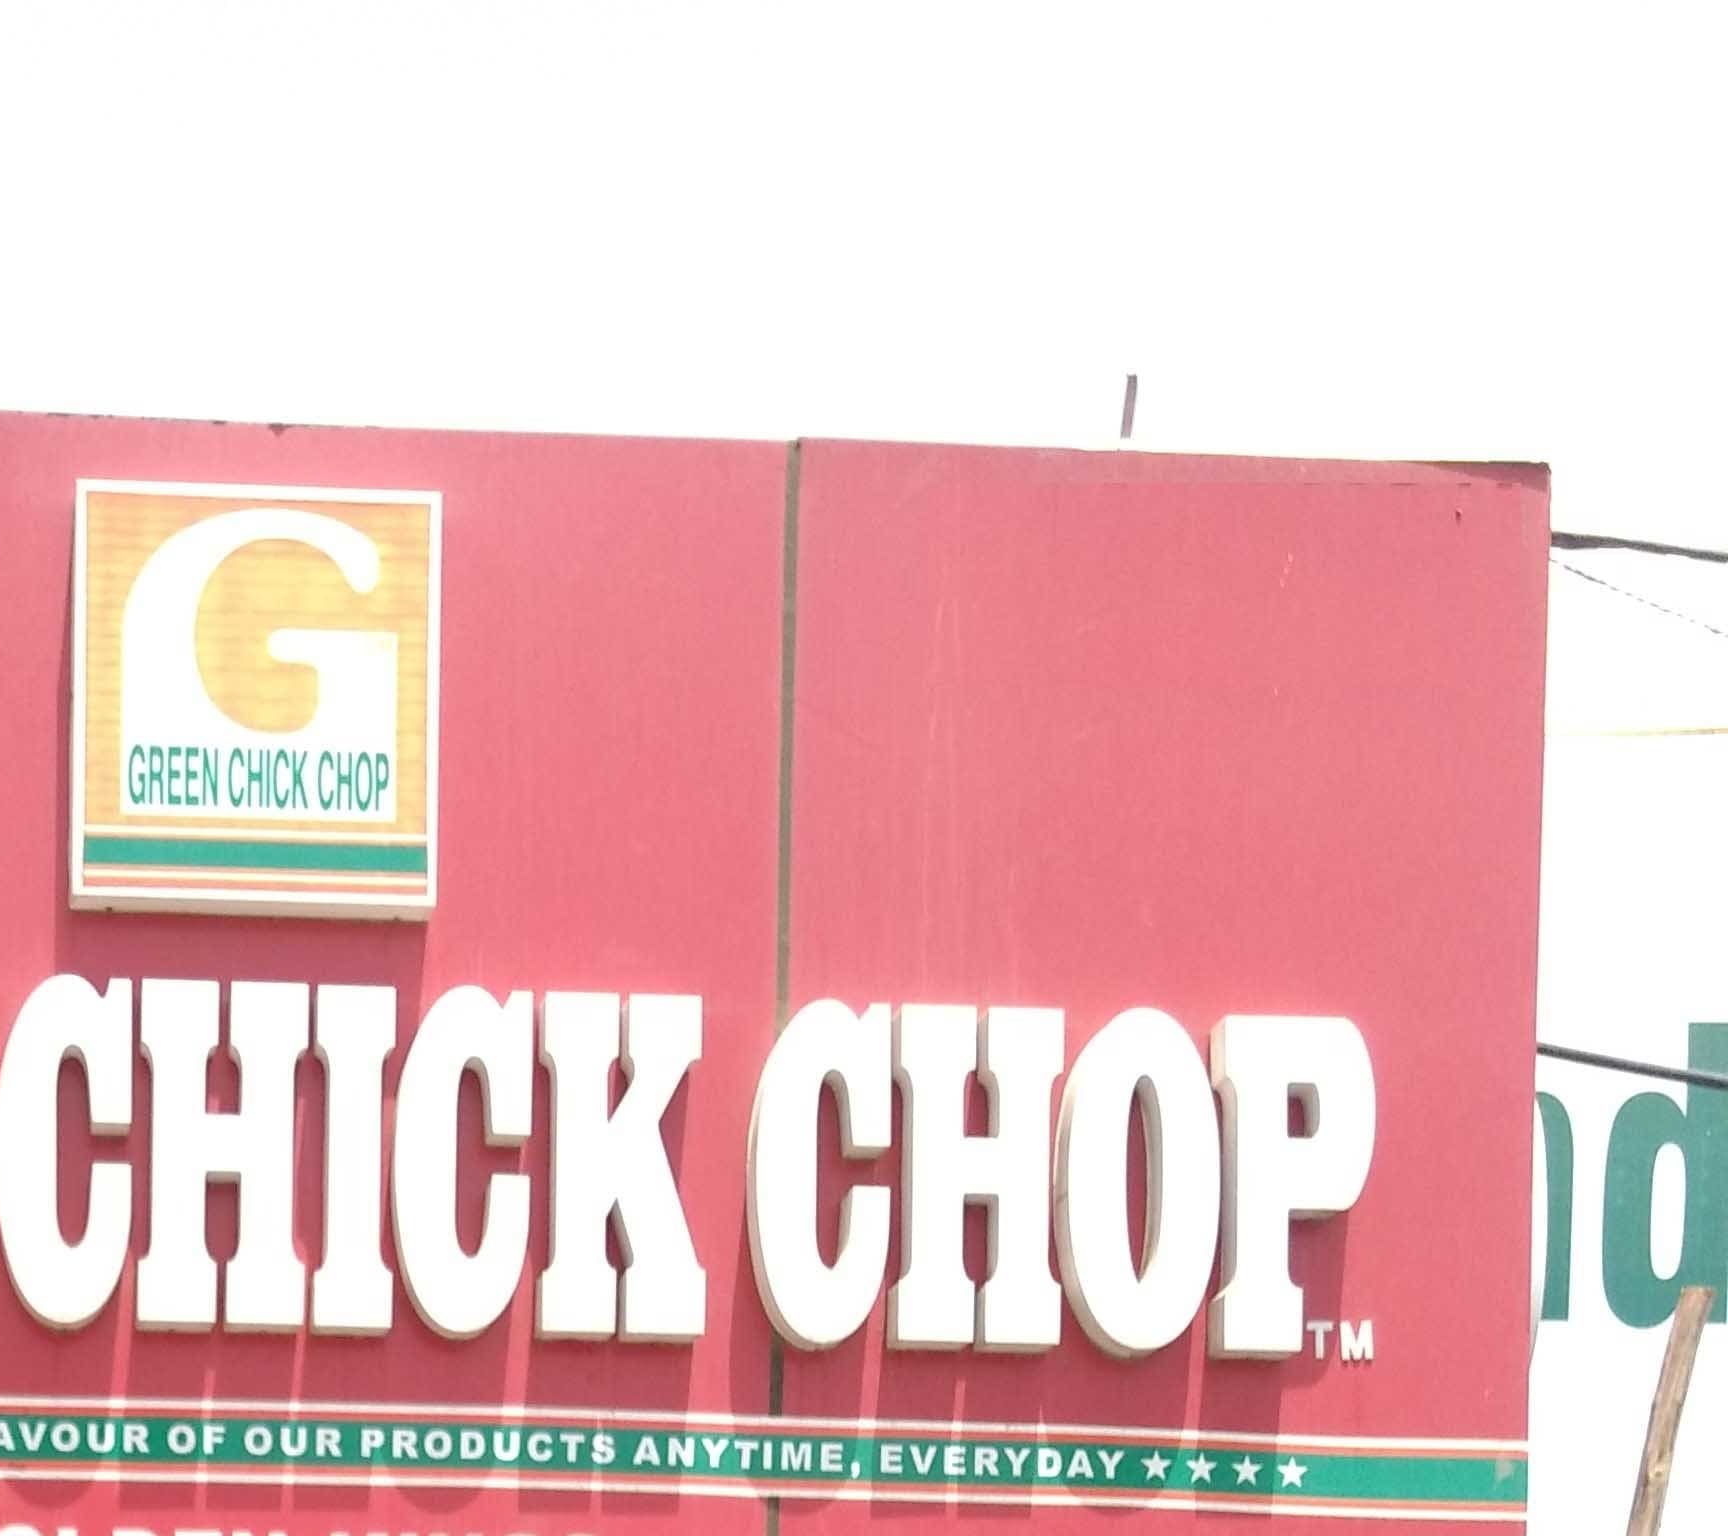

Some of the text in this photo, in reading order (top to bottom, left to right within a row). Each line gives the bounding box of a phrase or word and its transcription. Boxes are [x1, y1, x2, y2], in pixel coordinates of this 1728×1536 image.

[128, 745, 390, 812] GREEN CHICK CHOP
[748, 998, 1376, 1362] CHOP
[1306, 1319, 1374, 1362] TM
[167, 1424, 226, 1456] OF
[244, 1426, 343, 1459] OUR
[360, 1428, 616, 1466] PRODUCTS
[633, 1435, 861, 1480] ANYTIME,
[879, 1442, 1125, 1480] EVERYDAY
